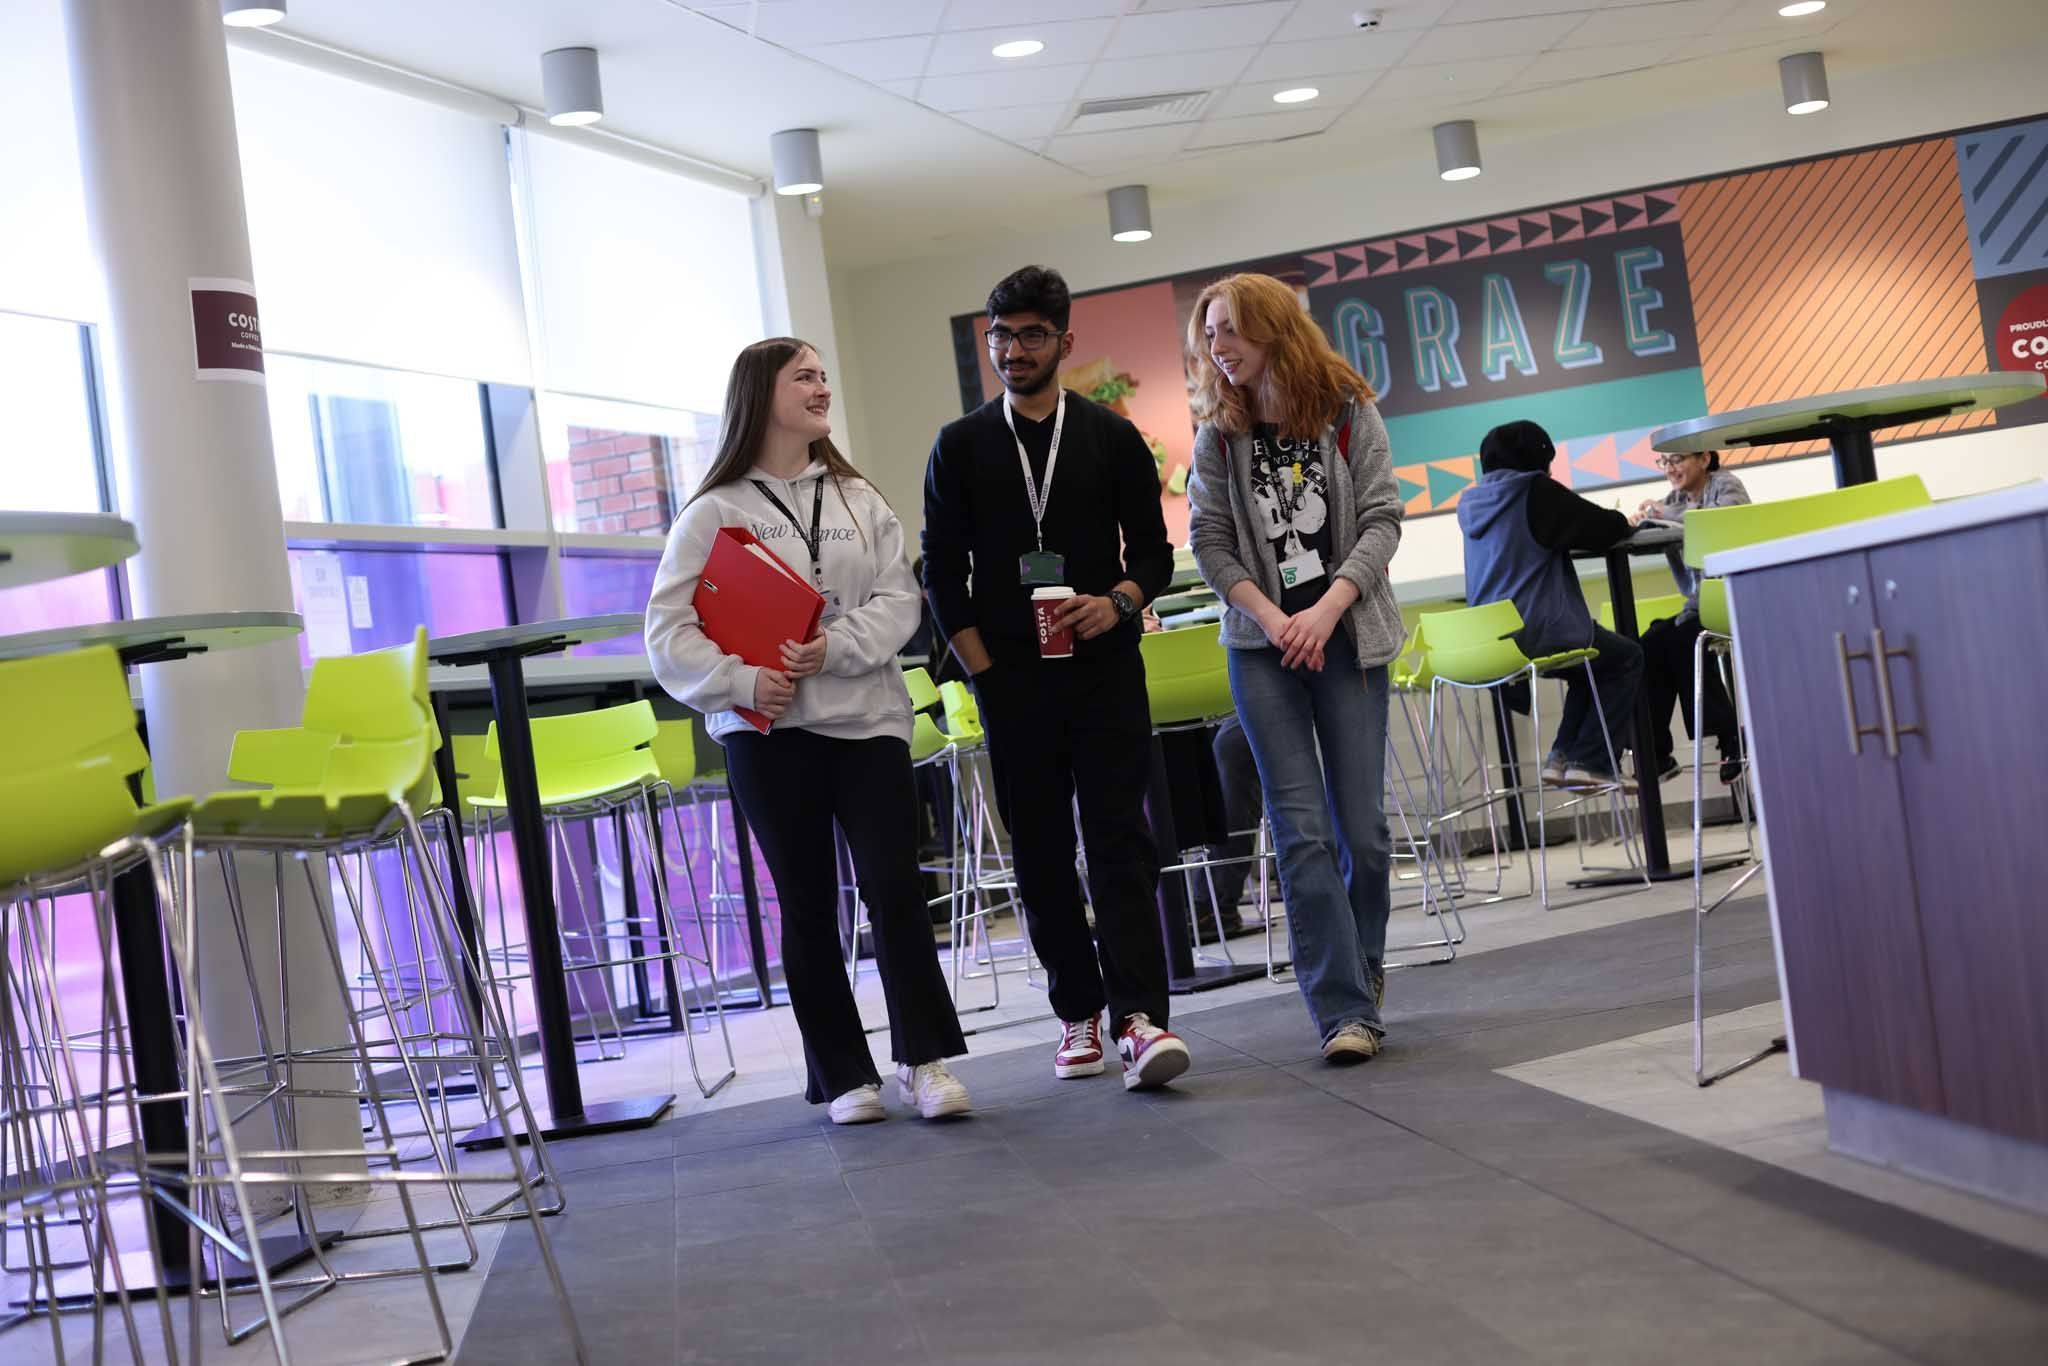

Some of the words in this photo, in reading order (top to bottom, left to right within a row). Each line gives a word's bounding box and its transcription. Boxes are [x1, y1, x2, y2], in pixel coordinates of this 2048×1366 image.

[1333, 245, 1676, 401] GRAZE
[2009, 319, 2048, 333] PROUDL
[751, 523, 788, 541] New
[1037, 607, 1048, 645] COSTA
